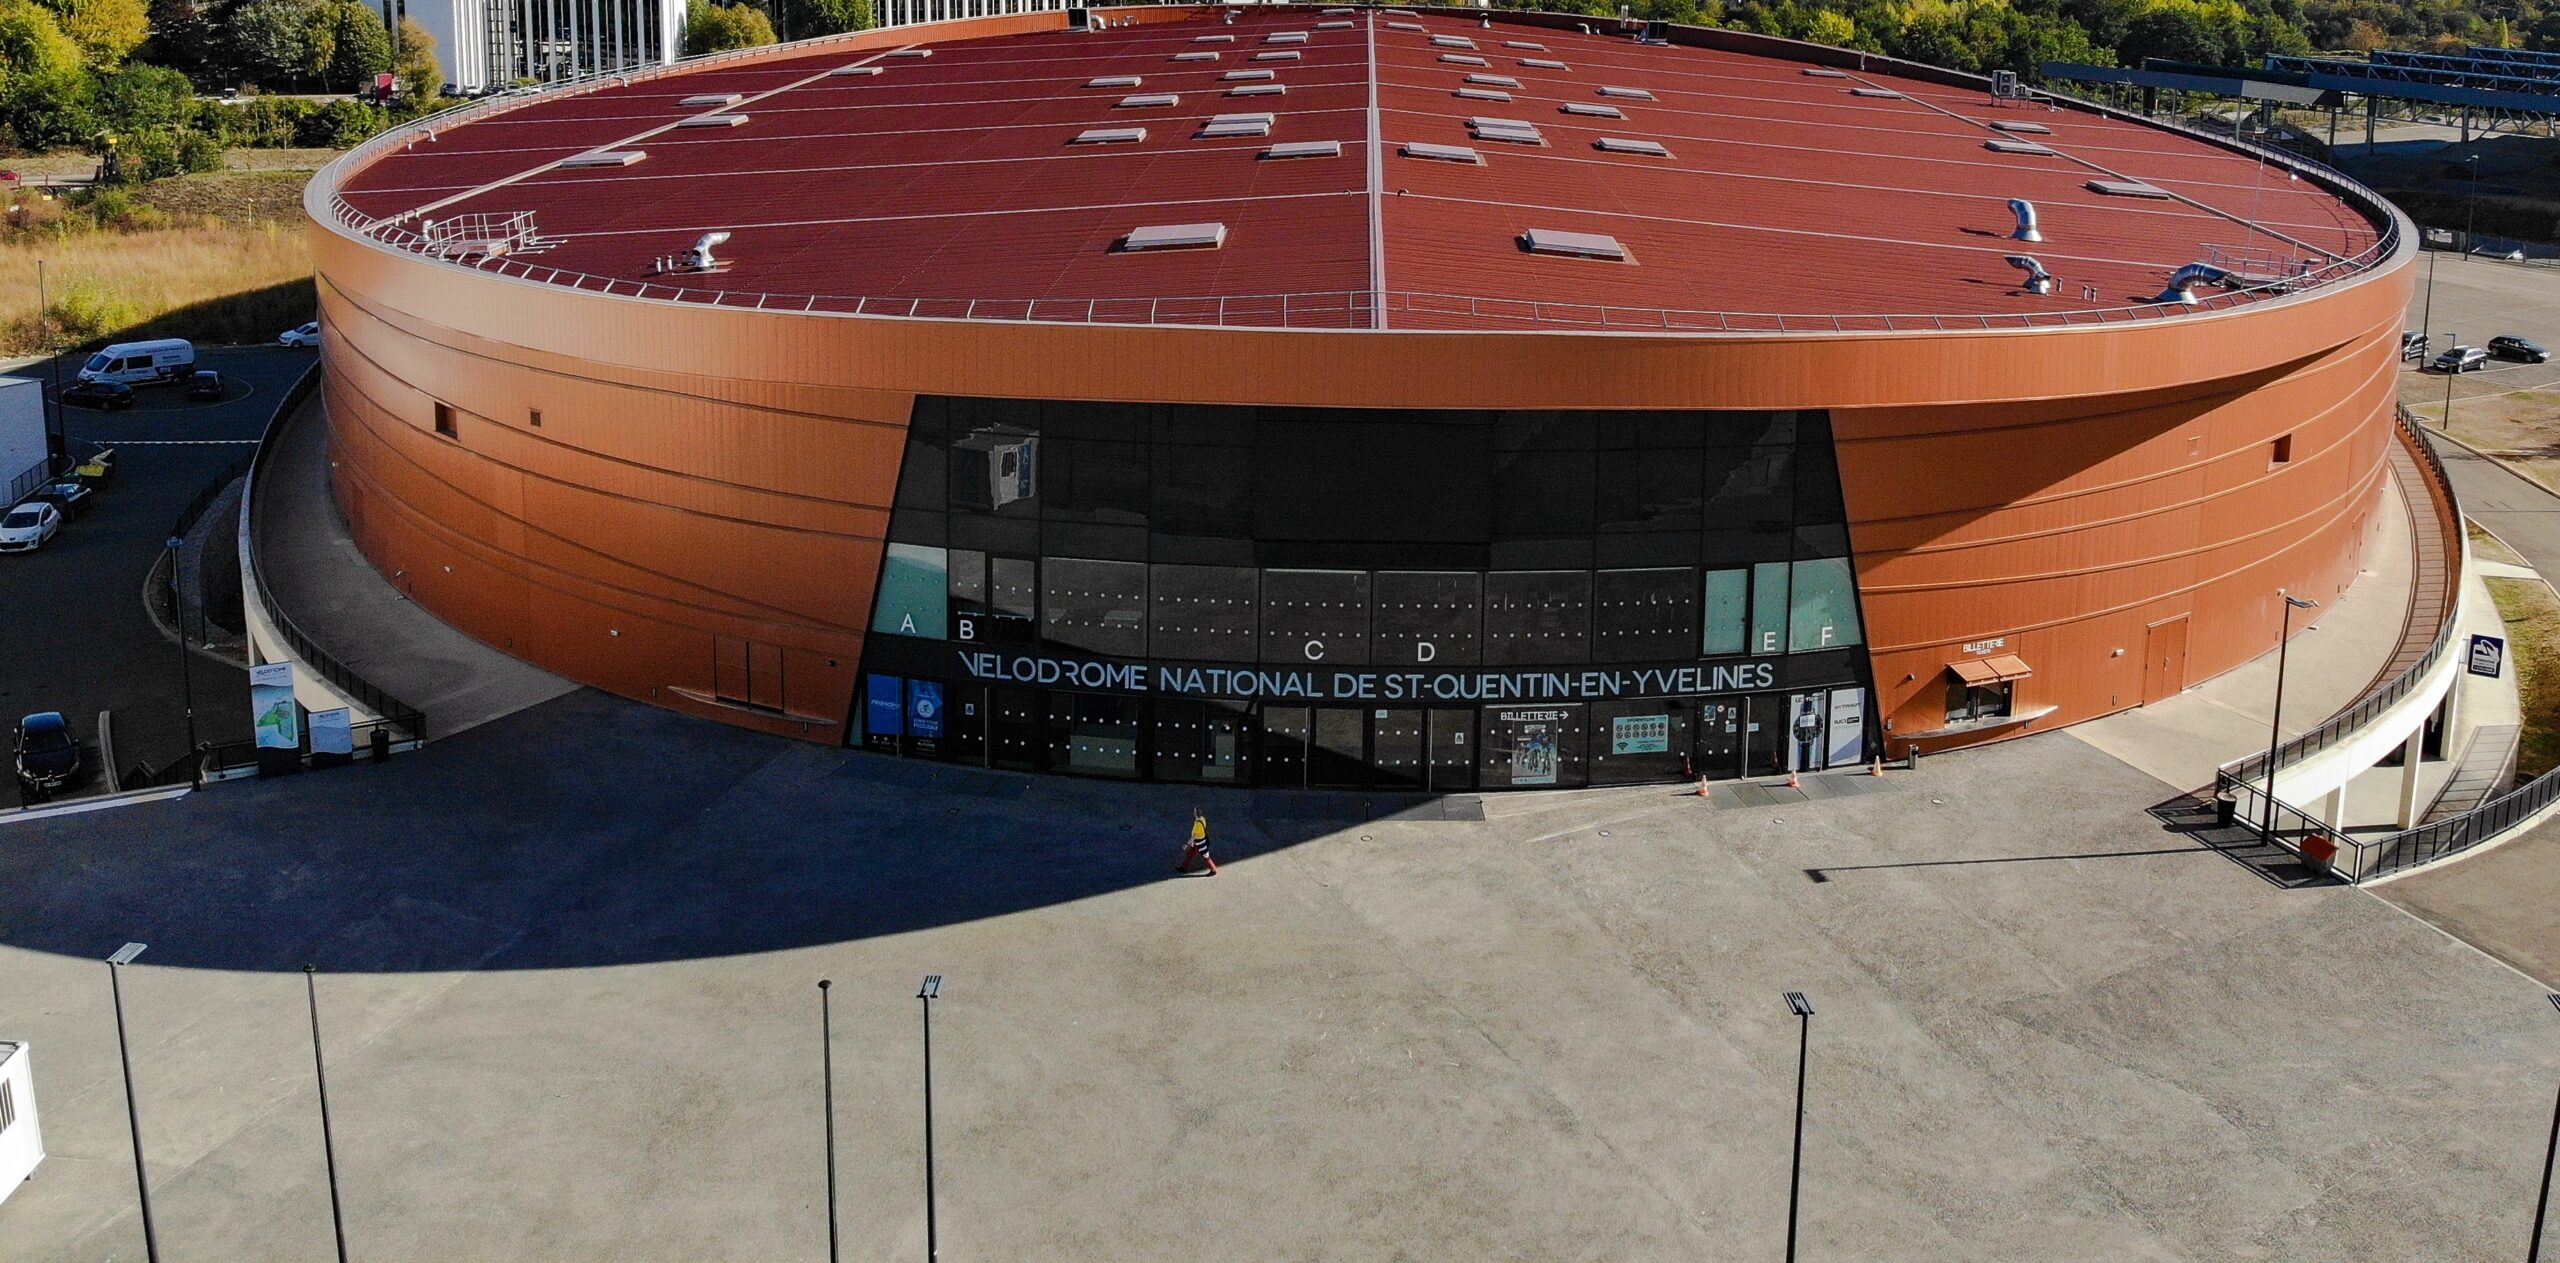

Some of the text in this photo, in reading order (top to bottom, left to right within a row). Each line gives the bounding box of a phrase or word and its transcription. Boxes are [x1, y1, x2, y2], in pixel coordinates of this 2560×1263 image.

[900, 613, 916, 634] A
[959, 619, 975, 640] B
[1763, 631, 1776, 651] E
[1820, 626, 1833, 646] F
[1963, 638, 2004, 652] BILLETTERIE
[1304, 640, 1324, 660] C
[1417, 642, 1435, 662] D
[1160, 667, 1323, 697] NATIONAL
[1333, 673, 1377, 698] DE
[1384, 663, 1774, 699] ST-QUENTIN-EN-YVELINES
[1500, 711, 1558, 720] BILLETTERIE
